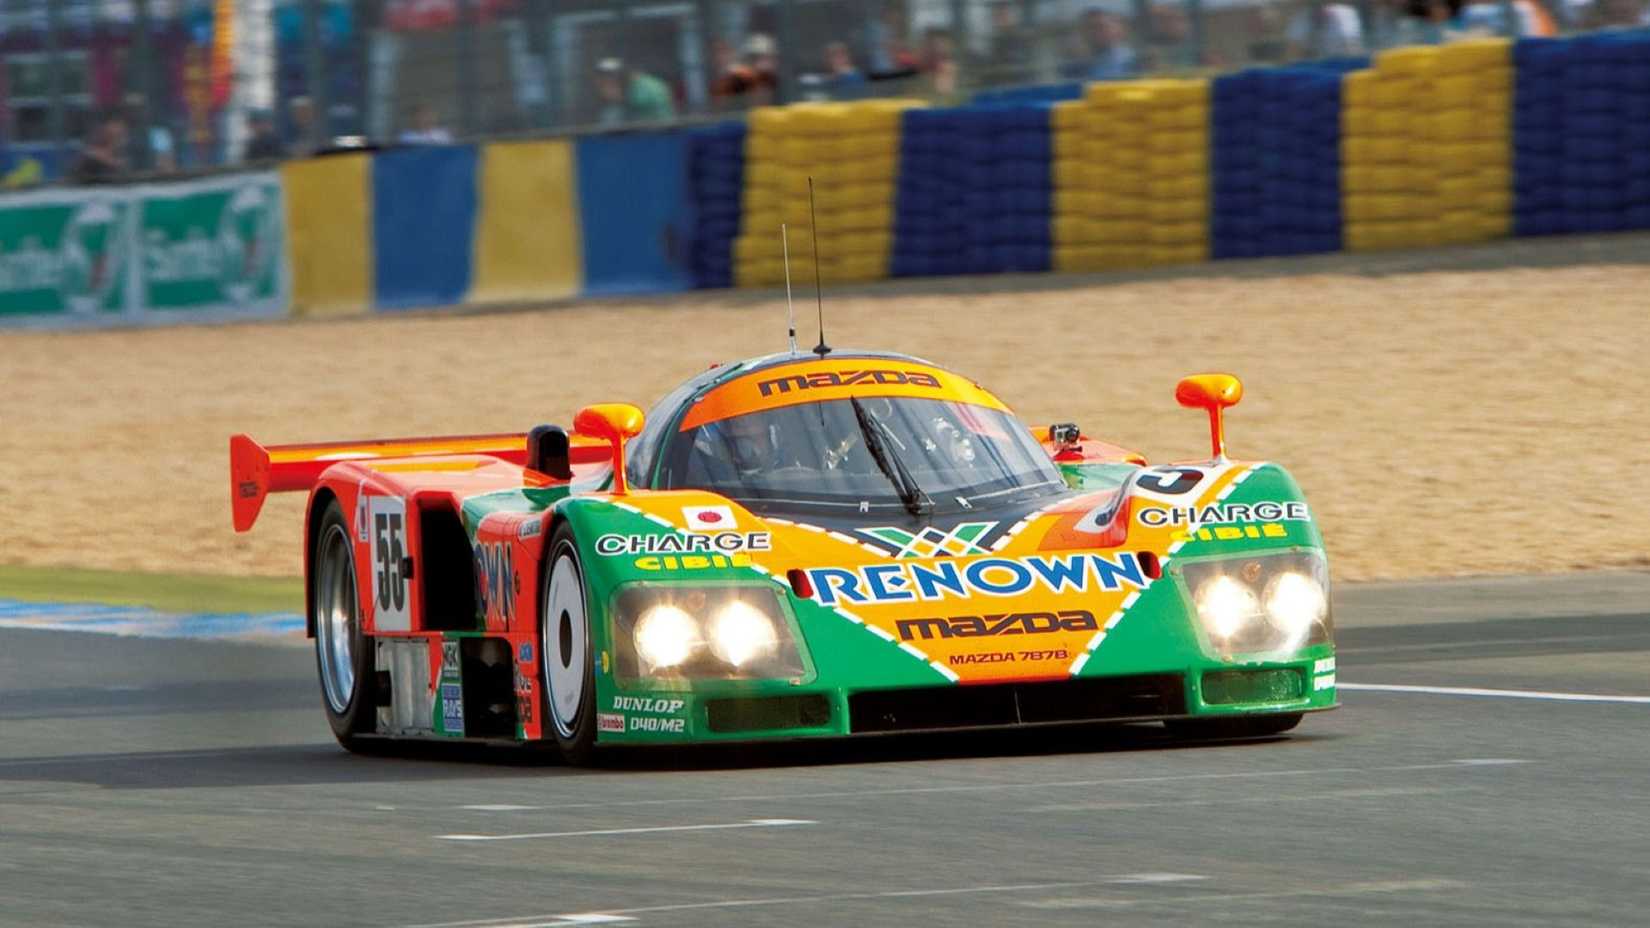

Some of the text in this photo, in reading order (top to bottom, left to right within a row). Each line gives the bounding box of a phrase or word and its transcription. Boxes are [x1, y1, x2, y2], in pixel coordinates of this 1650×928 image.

[1138, 502, 1310, 527] CHARGE
[597, 532, 771, 554] CHARGE
[375, 513, 405, 612] 55
[808, 552, 1147, 604] RENOWN
[949, 652, 1016, 665] MAZDA
[613, 696, 684, 713] DUNLOP
[630, 717, 685, 733] D40/M2
